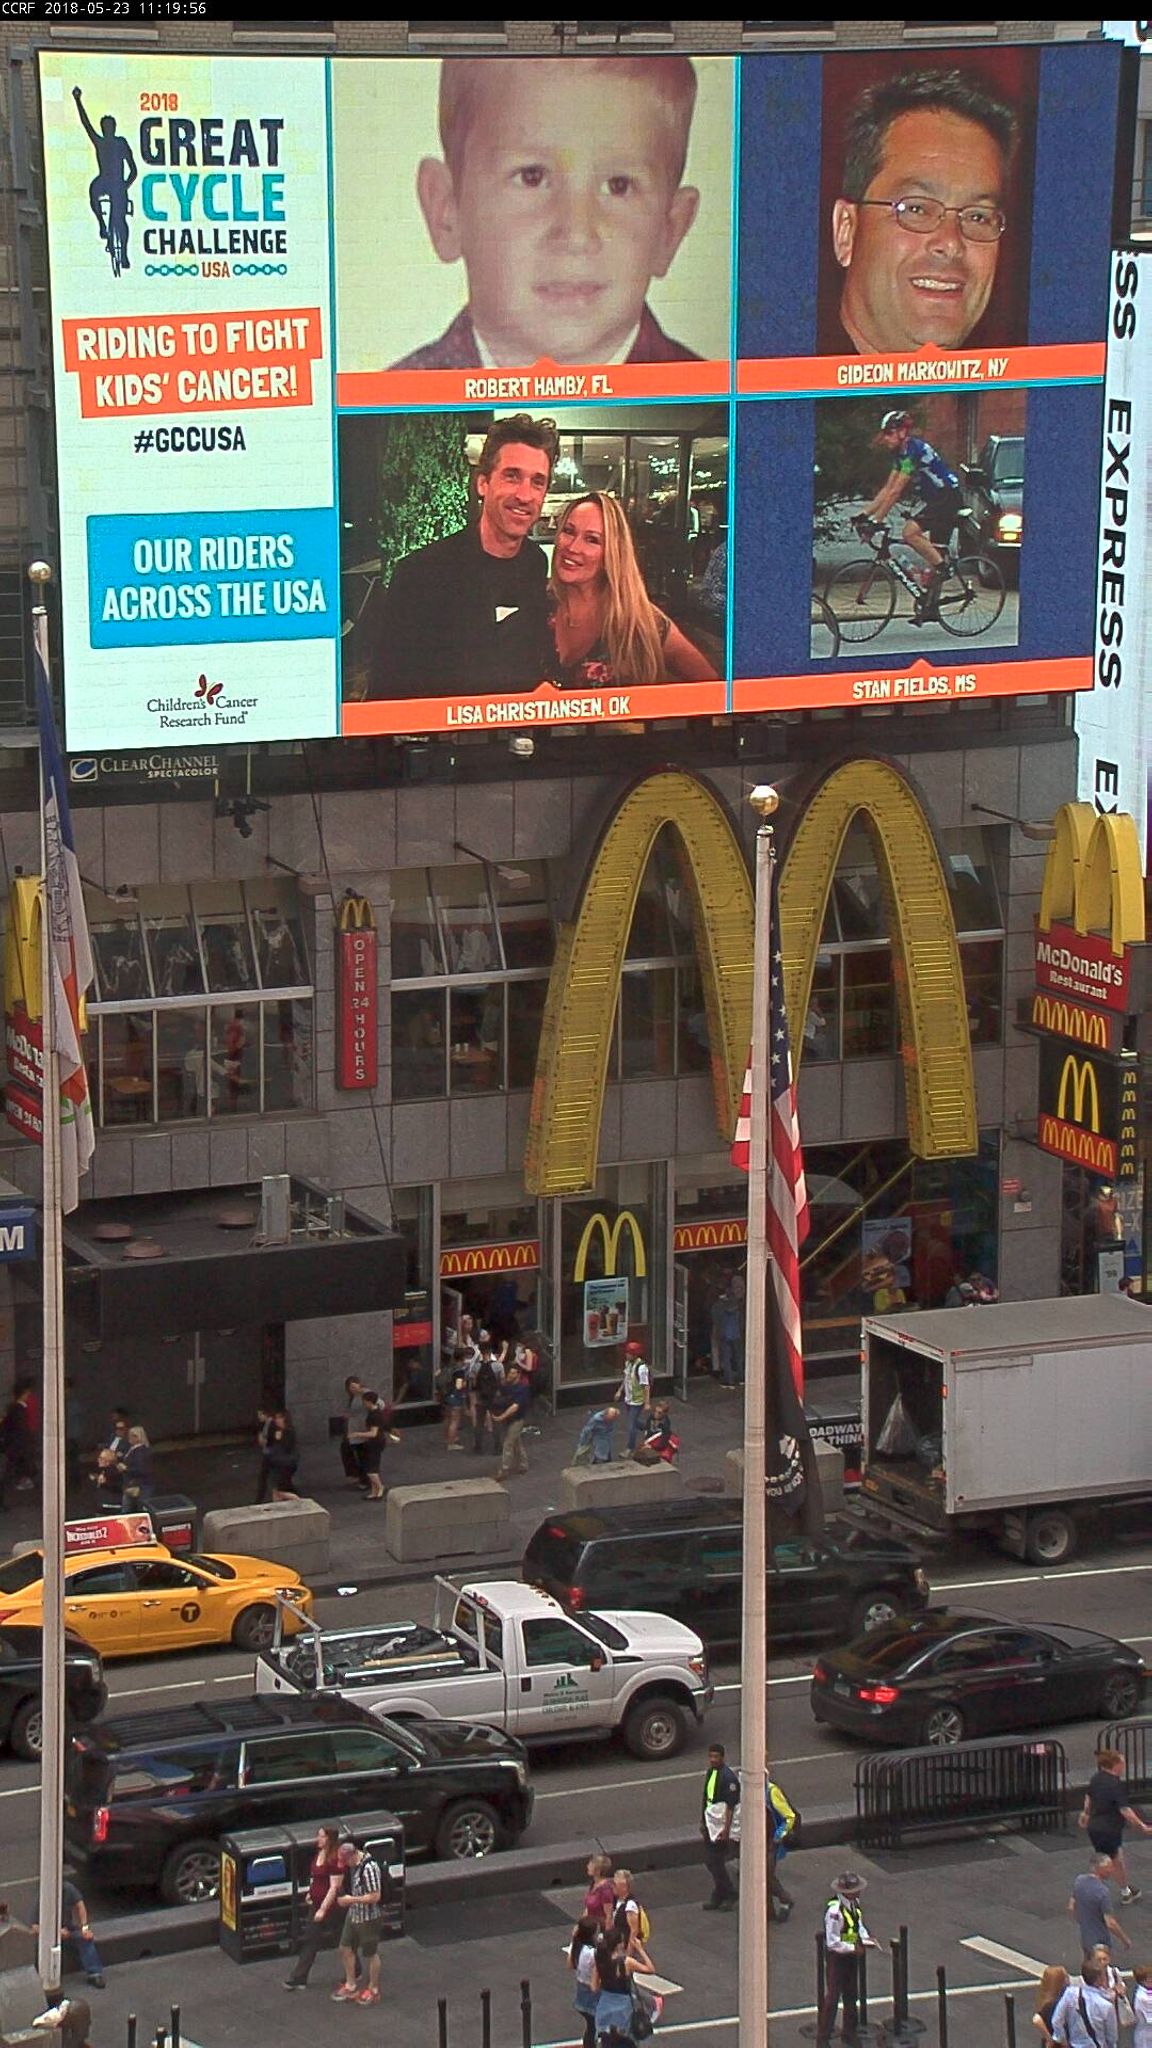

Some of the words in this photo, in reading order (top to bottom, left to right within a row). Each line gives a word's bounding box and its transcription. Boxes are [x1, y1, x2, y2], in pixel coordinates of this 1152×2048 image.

[139, 92, 179, 112] 2018
[139, 116, 285, 168] GREAT
[140, 173, 287, 223] CYCLE
[143, 228, 288, 255] CHALLENGE
[201, 261, 231, 278] USA
[76, 325, 176, 361] RIDING
[181, 323, 218, 356] TO
[225, 318, 311, 353] FIGHT
[177, 366, 298, 405] CANCER!
[837, 363, 894, 384] GIDEON
[898, 358, 985, 382] MARKOWITZ,
[988, 357, 1009, 377] NY
[464, 375, 531, 398] ROBERT
[534, 374, 588, 397] HAMBY,
[591, 374, 613, 395] FL
[133, 425, 247, 455] #GCCUSA
[133, 538, 193, 574] OUR
[200, 534, 295, 572] RIDERS
[1097, 399, 1132, 690] EXPRESS
[102, 584, 212, 622] ACROSS
[217, 580, 267, 617] THE
[272, 578, 327, 615] USA
[852, 679, 891, 699] STAN
[893, 677, 950, 697] FIELDS,
[954, 675, 976, 694] MS
[215, 696, 259, 709] Cancer
[446, 703, 483, 726] LISA
[485, 697, 606, 723] CHRISTIANSEN,
[609, 695, 631, 716] OK
[159, 712, 213, 728] Research
[147, 767, 219, 779] SPECTACOLOR
[353, 939, 366, 992] OPEN
[1037, 941, 1123, 987] McDonald's
[1049, 970, 1108, 1000] Restaurant
[351, 997, 370, 1010] 24
[353, 1013, 366, 1081] HOURS
